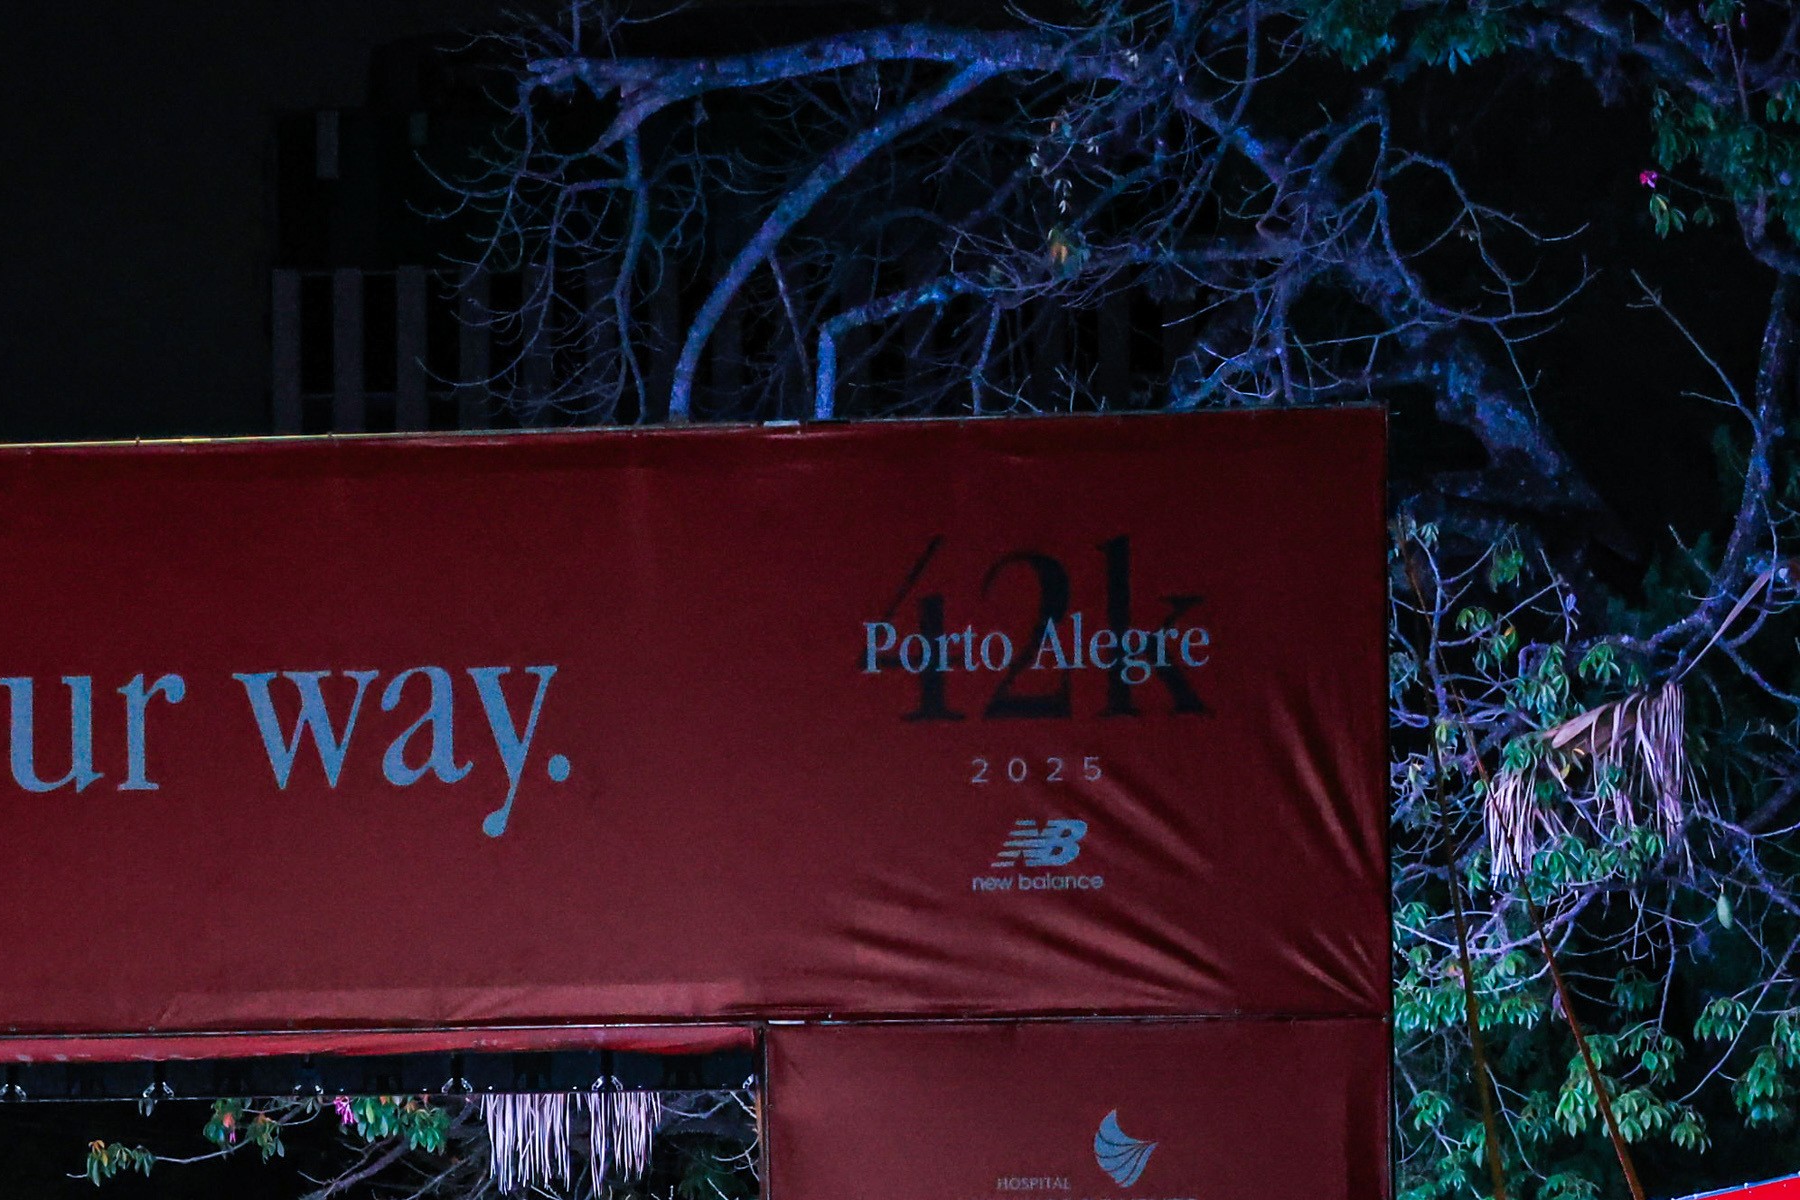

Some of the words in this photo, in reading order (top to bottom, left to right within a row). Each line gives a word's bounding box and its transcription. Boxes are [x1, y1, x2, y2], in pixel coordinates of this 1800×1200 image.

[861, 621, 1013, 674] Porto
[1031, 612, 1210, 685] Alegre
[231, 664, 573, 838] way.
[971, 756, 1102, 784] 2025
[972, 876, 1012, 891] new
[1018, 873, 1104, 891] balance
[997, 1177, 1071, 1191] HOSPITAL
